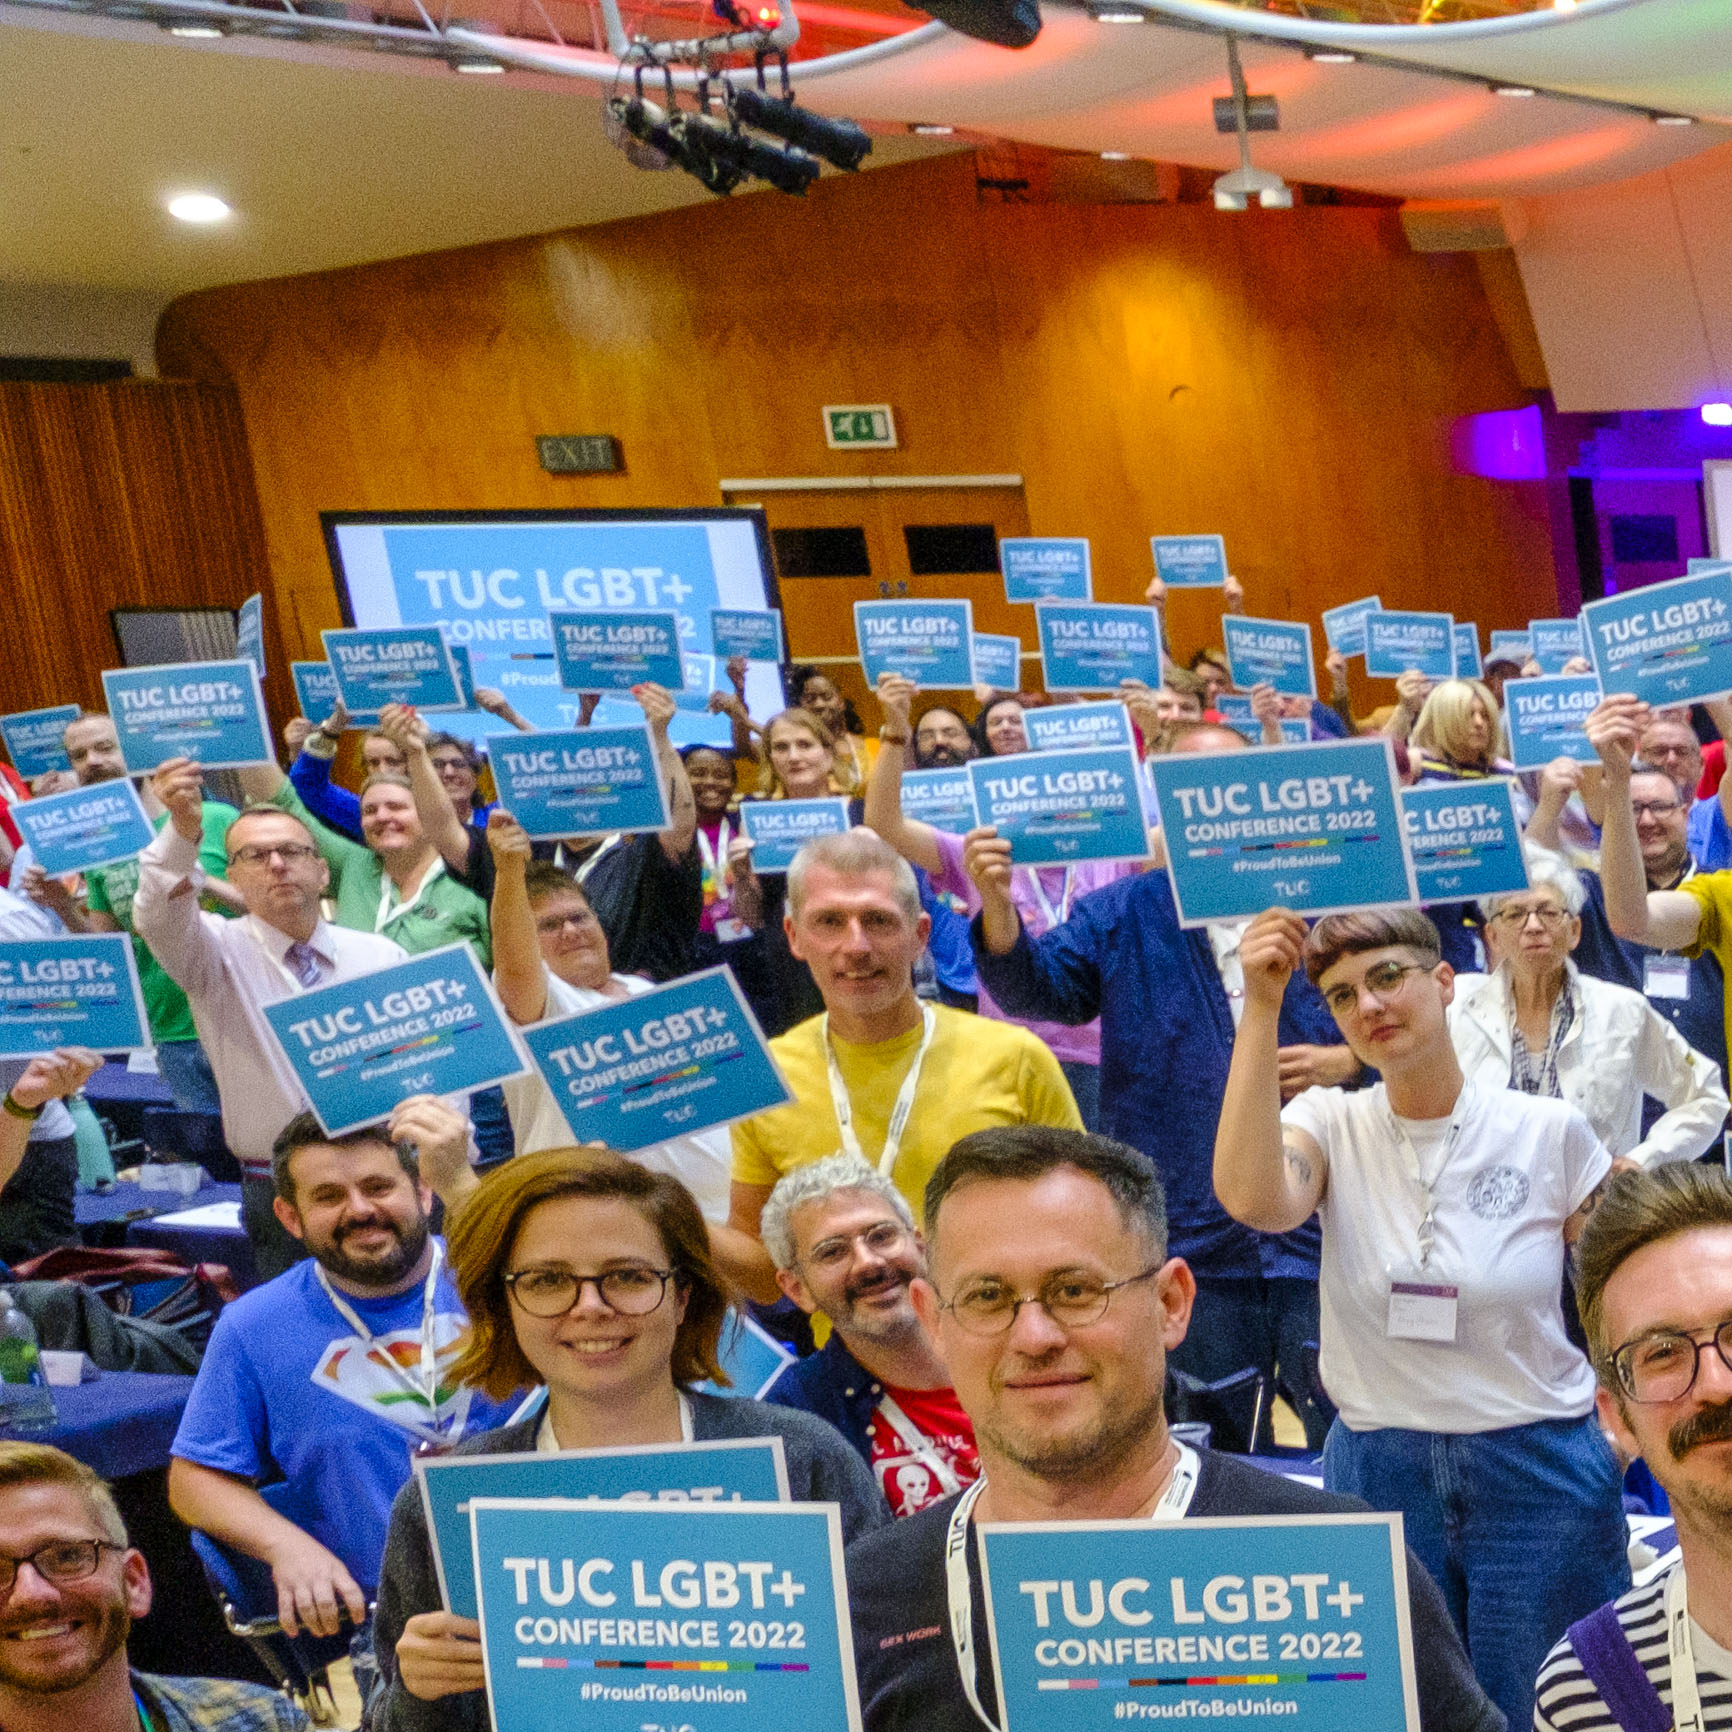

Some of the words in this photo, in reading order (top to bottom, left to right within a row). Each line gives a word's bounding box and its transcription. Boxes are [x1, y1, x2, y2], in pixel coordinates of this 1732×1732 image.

[541, 438, 608, 468] EXIT
[415, 568, 526, 609] TUC
[535, 567, 693, 607] LGBT+
[116, 686, 166, 709] TUC
[170, 680, 243, 704] LGBT+
[1171, 783, 1252, 819] TUC
[1258, 774, 1374, 811] LGBT+
[1184, 814, 1321, 842] CONFERENCE
[1324, 810, 1376, 830] 2022
[287, 1006, 363, 1047] TUC
[363, 978, 467, 1025] LGBT+
[308, 1016, 430, 1065] CONFERENCE
[430, 1003, 477, 1028] 2022
[546, 1034, 622, 1076] TUC
[622, 1005, 727, 1054] LGBT+
[568, 1046, 690, 1095] CONFERENCE
[690, 1032, 738, 1058] 2022
[501, 1558, 617, 1606] TUC
[631, 1558, 805, 1609] LGBT+
[1018, 1576, 1154, 1628] TUC
[1170, 1573, 1364, 1623] LGBT+
[513, 1617, 720, 1647] CONFERENCE
[727, 1620, 805, 1651] 2022
[1034, 1633, 1269, 1667] CONFERENCE
[1278, 1632, 1363, 1660] 2022
[581, 1682, 745, 1705] #ProudToBeUnion
[1113, 1697, 1297, 1718] #ProudToBeUnion
